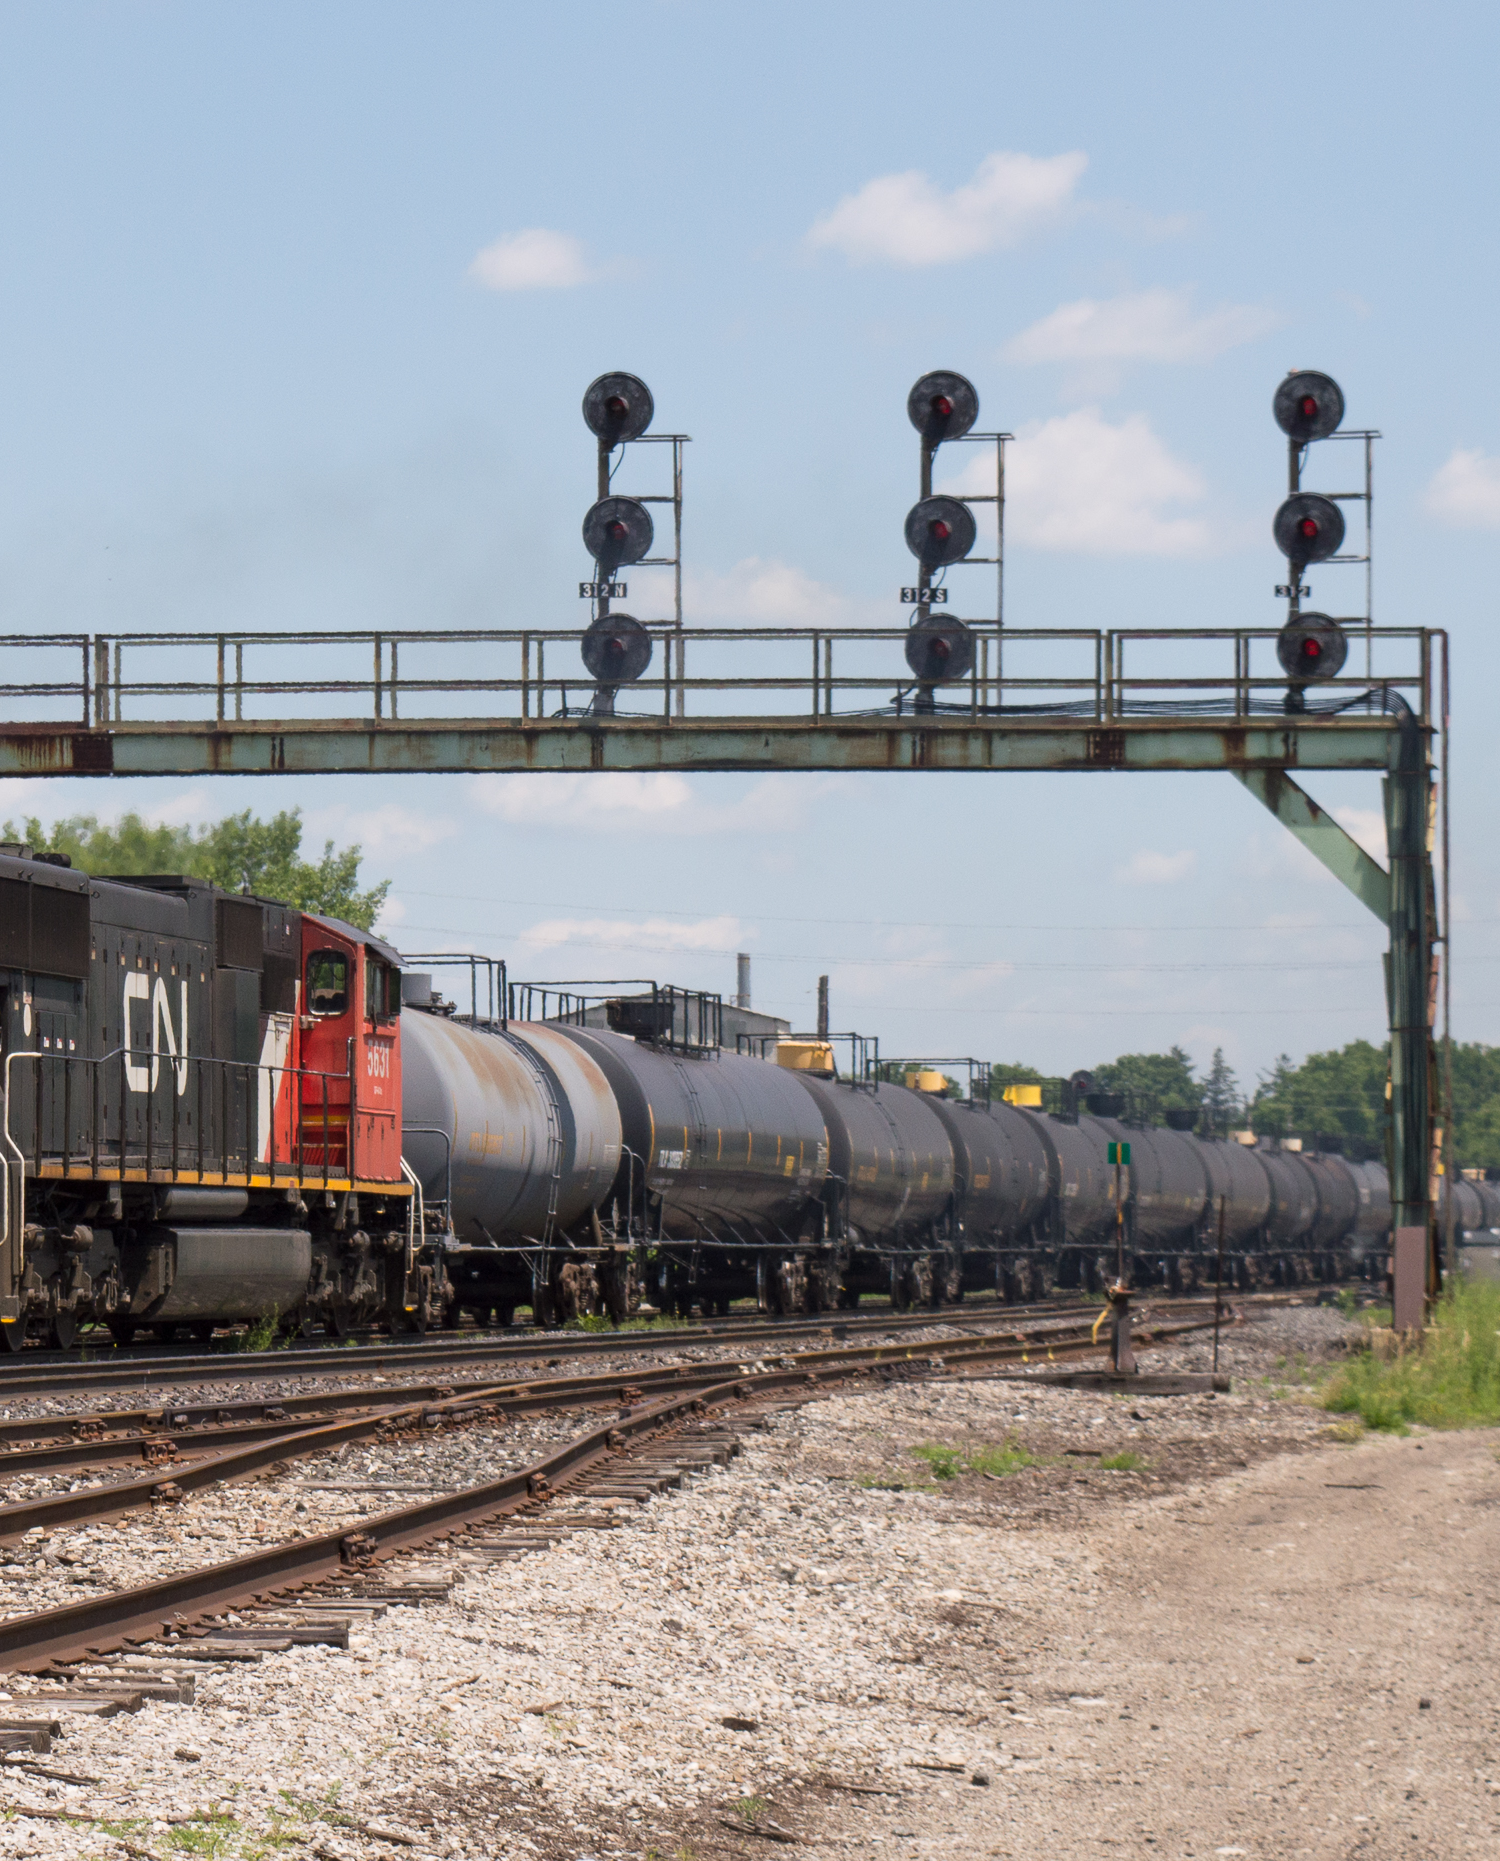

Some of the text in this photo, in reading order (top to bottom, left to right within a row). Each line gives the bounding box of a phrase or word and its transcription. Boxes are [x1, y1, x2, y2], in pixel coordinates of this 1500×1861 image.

[1276, 585, 1309, 598] 312
[123, 971, 188, 1096] CN
[367, 1039, 390, 1078] 5631
